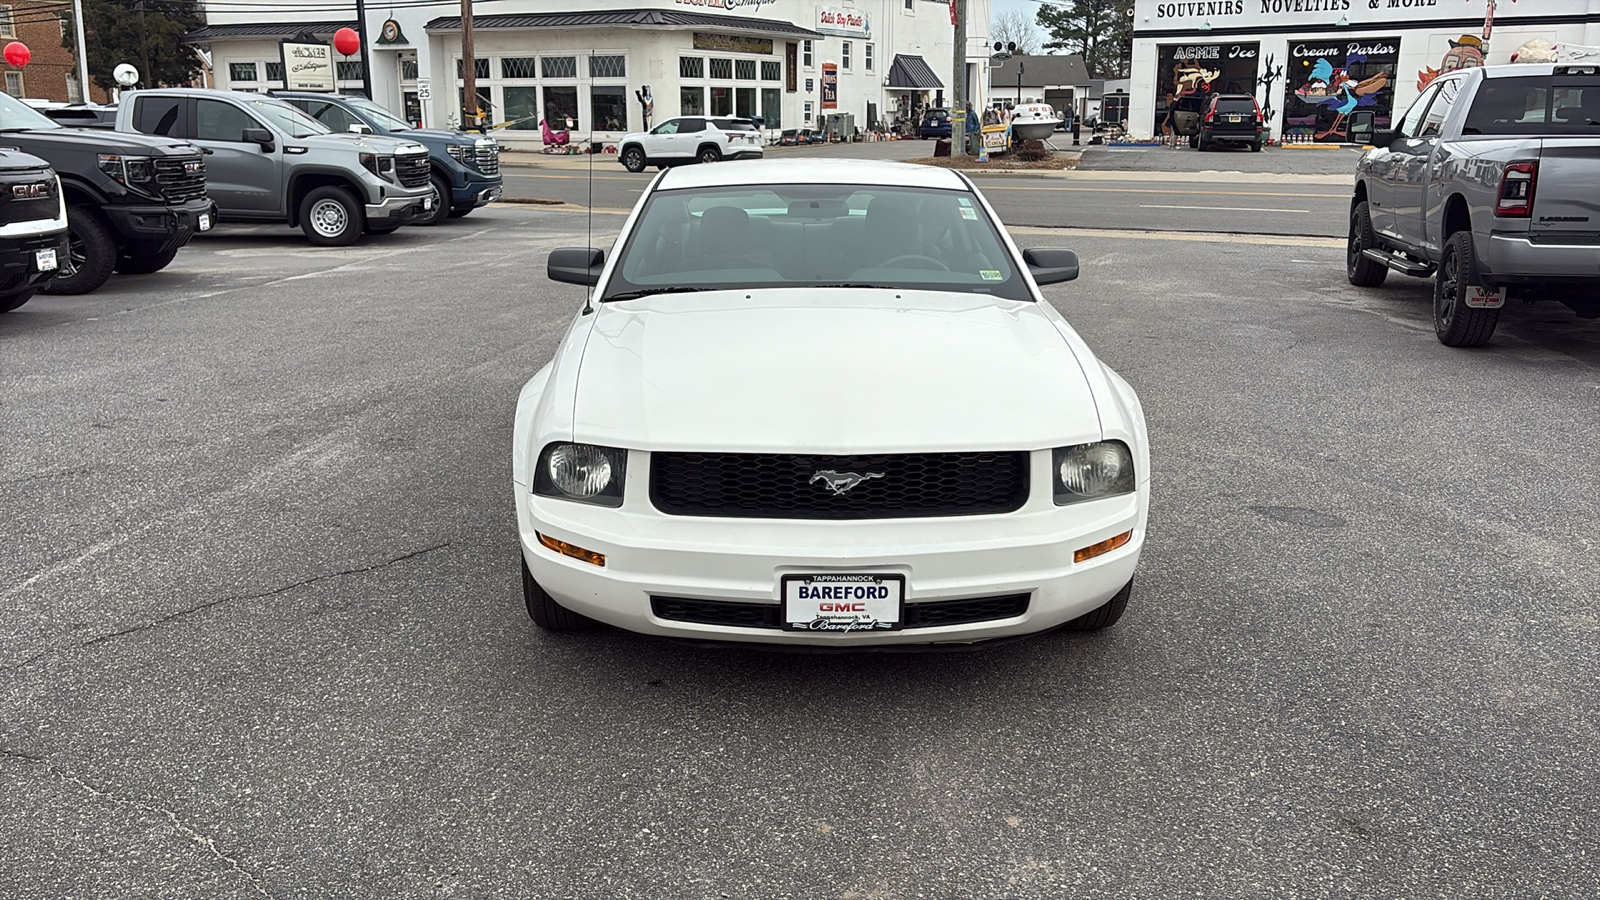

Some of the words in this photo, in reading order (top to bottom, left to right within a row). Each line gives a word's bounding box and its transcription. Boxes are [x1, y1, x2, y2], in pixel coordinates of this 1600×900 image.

[1157, 1, 1243, 18] SOUVENIRS
[1260, 0, 1350, 13] NOVELTIES
[1368, 0, 1380, 9] &
[821, 11, 835, 23] Dutch
[837, 13, 847, 28] Boy
[847, 14, 862, 27] Paints
[1173, 46, 1220, 59] ACME
[1228, 45, 1257, 58] Ice
[1293, 44, 1340, 57] Cream
[1346, 42, 1397, 56] Parlor
[420, 89, 430, 98] 25
[825, 89, 836, 100] TEA
[12, 184, 48, 199] GMC
[798, 586, 889, 600] BAREFORD
[819, 602, 866, 612] GMC
[809, 619, 878, 634] Bareford
